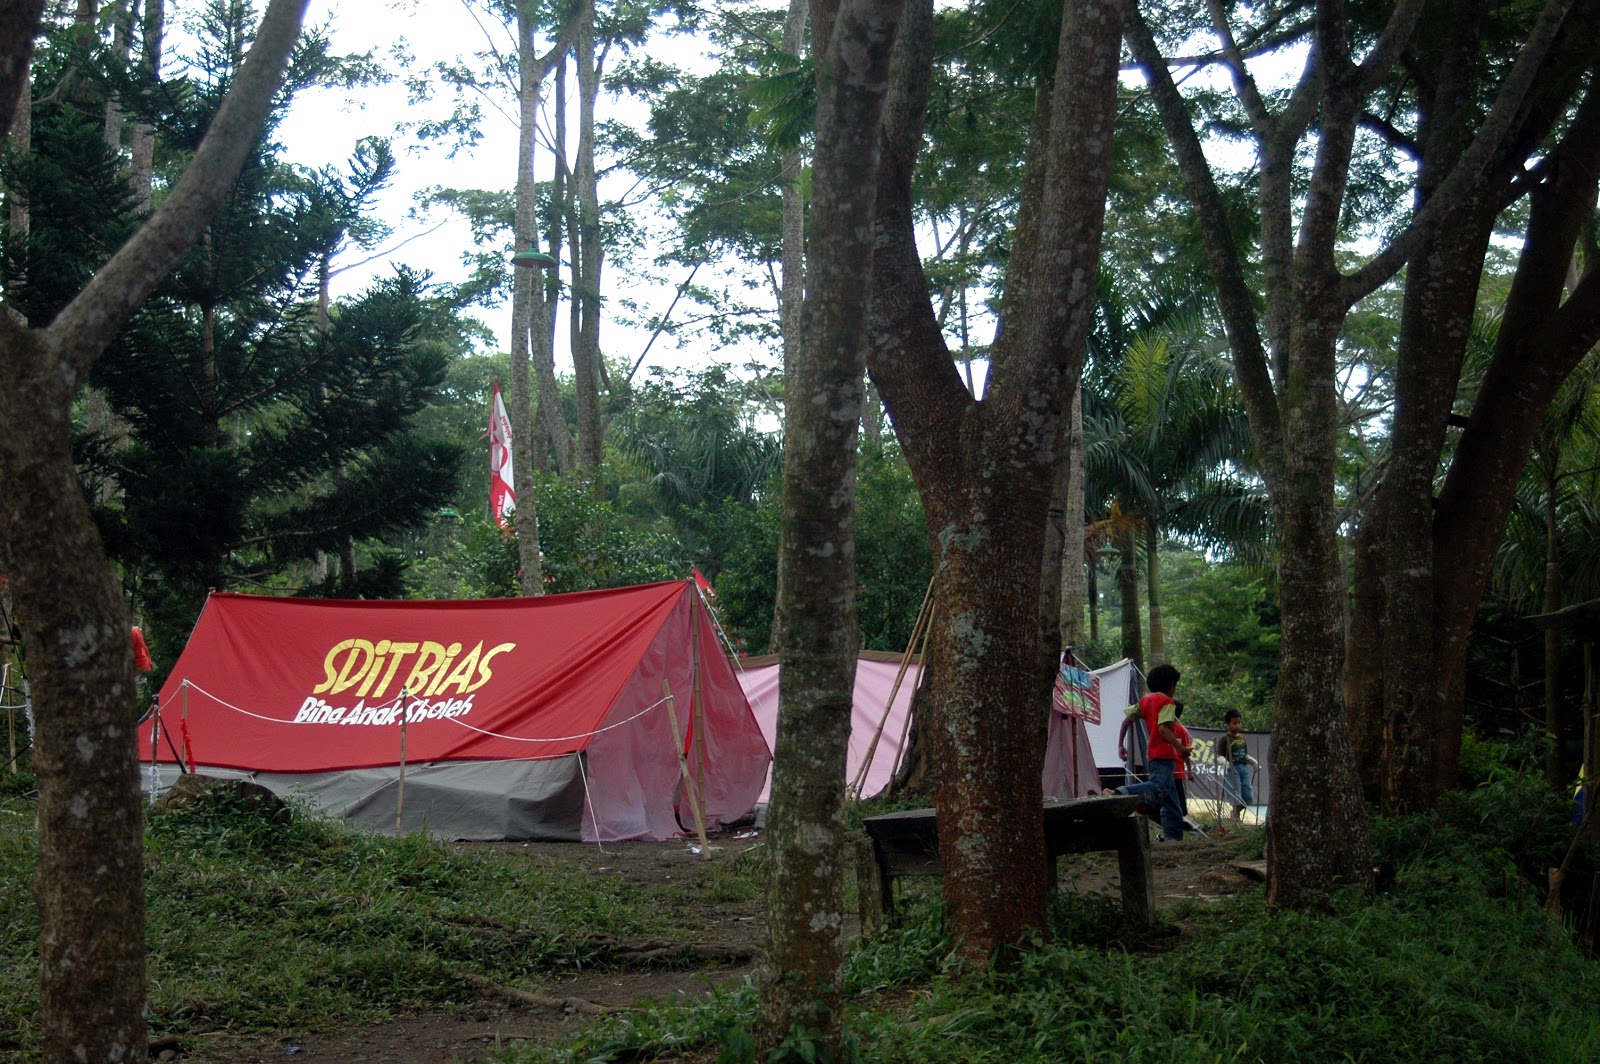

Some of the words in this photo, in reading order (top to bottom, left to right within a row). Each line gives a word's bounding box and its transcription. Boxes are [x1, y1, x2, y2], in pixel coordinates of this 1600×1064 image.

[294, 696, 347, 724] Bina
[340, 699, 404, 726] Anak
[398, 694, 476, 726] Sholeh
